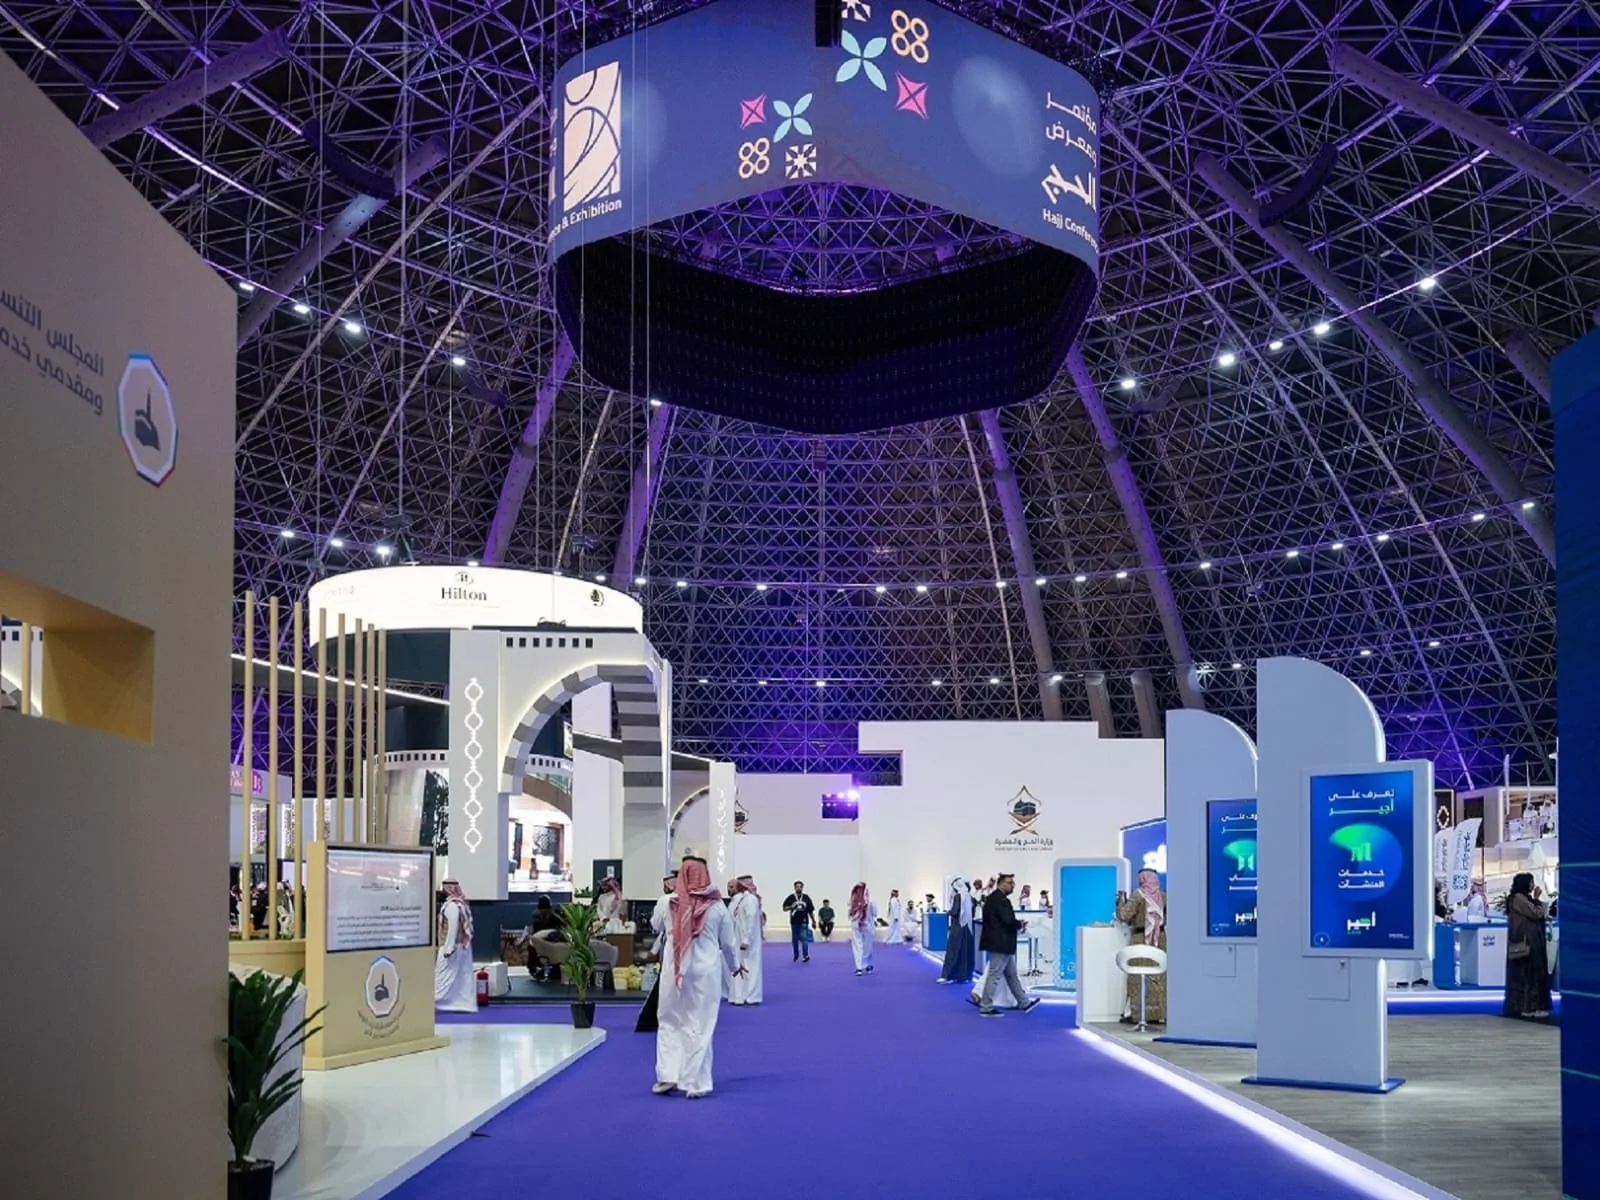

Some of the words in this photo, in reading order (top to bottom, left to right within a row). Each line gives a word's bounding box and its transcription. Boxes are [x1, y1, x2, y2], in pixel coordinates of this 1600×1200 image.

[569, 199, 622, 225] Exhibition
[1043, 208, 1063, 229] Hajj
[46, 329, 104, 377] المجلس
[36, 353, 103, 416] ومقدمي
[441, 586, 487, 601] Hilton
